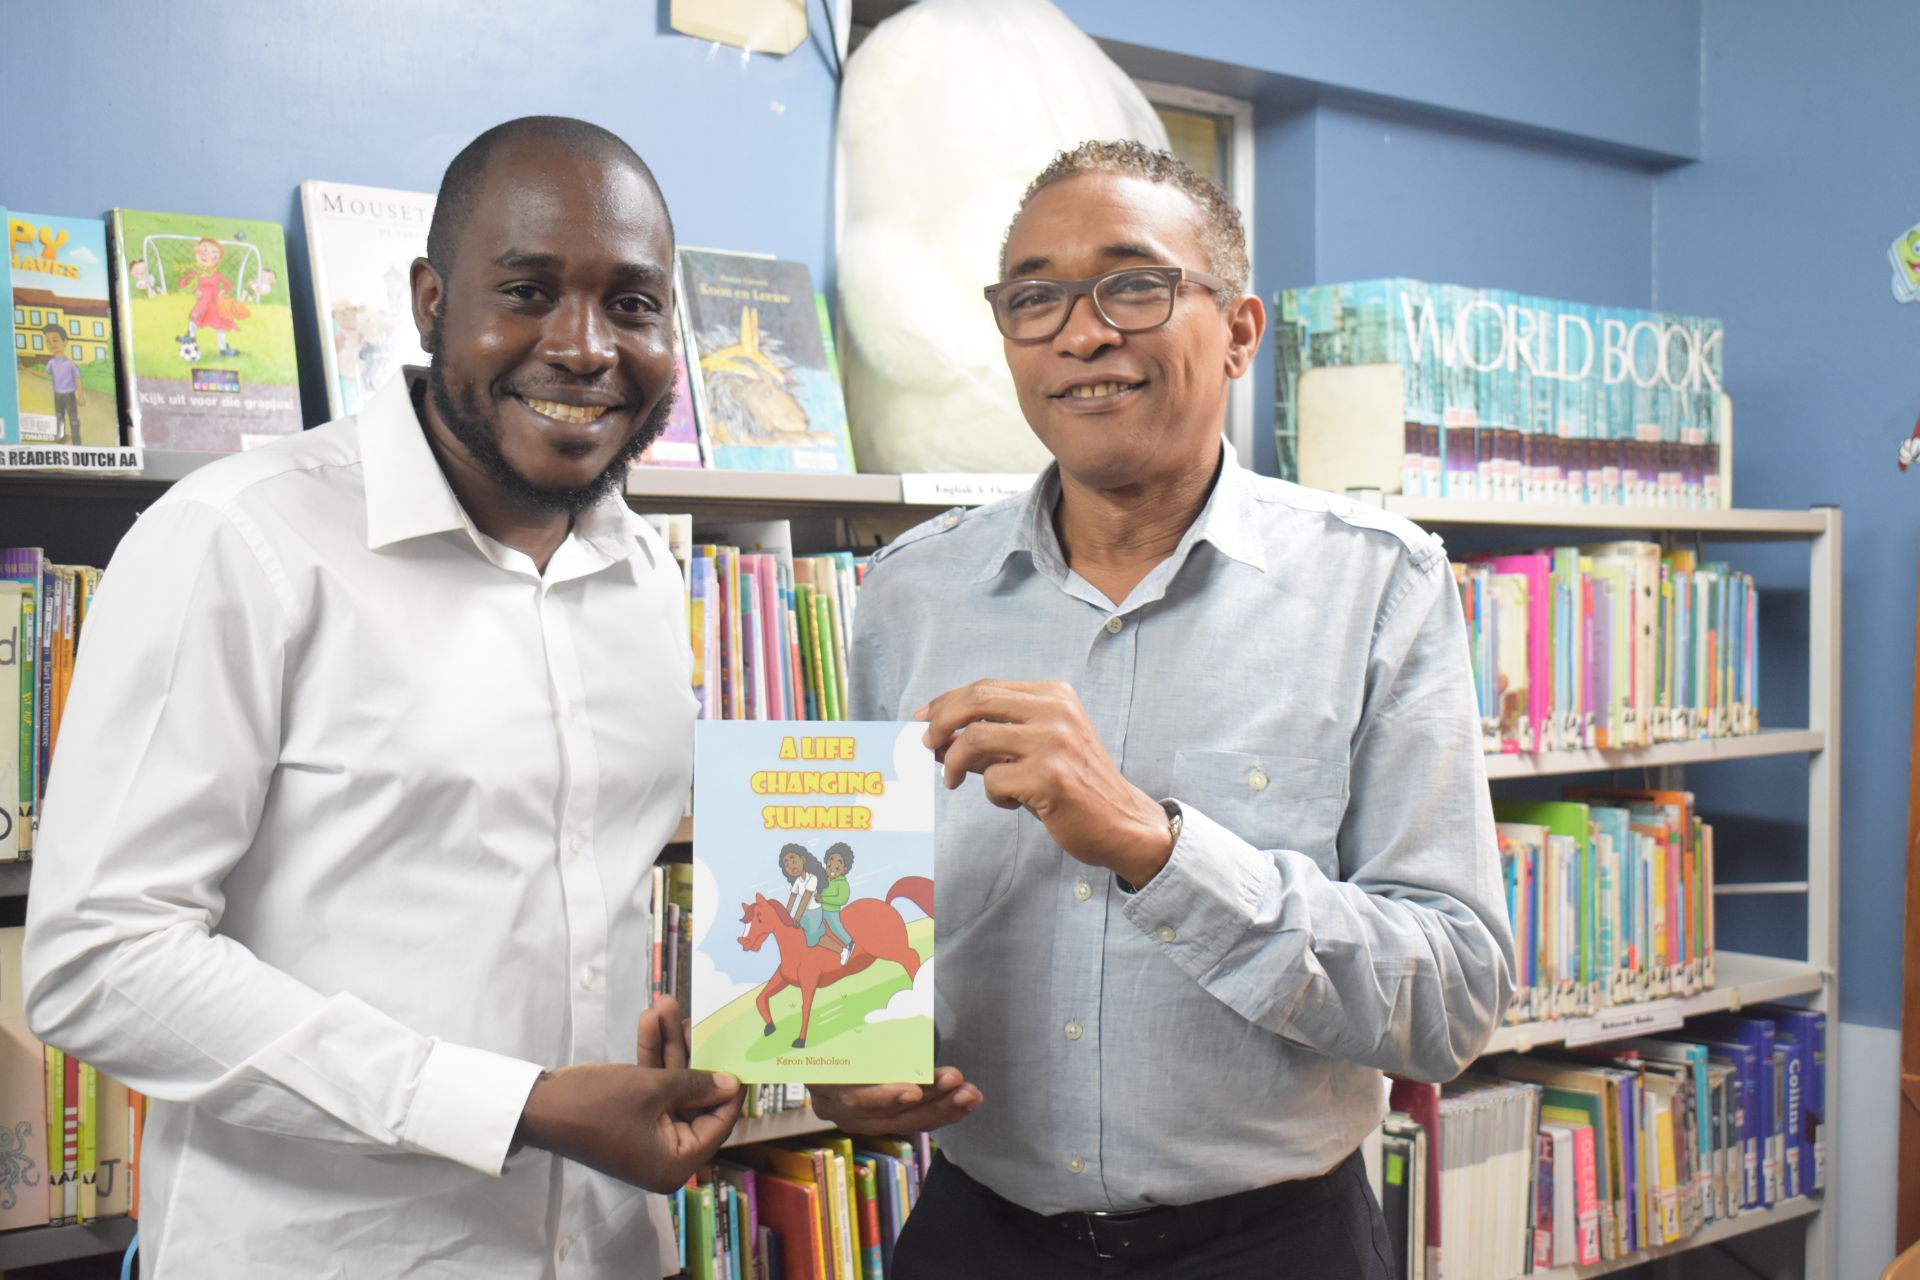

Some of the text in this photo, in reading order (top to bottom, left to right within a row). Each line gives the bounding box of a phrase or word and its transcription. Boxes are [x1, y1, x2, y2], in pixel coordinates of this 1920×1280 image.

[323, 193, 427, 223] MOUSET
[1401, 290, 1724, 393] WORLD BOOK
[140, 392, 165, 406] Kijk
[169, 394, 186, 406] uit
[190, 396, 218, 407] voor
[9, 450, 70, 467] READERS
[72, 452, 116, 467] DUTCH
[119, 453, 138, 467] AA
[43, 661, 51, 680] Bart
[779, 735, 856, 761] A LIFE
[750, 769, 885, 796] CHANGING
[761, 804, 873, 831] SUMMER
[776, 1055, 851, 1066] Keron Nicholson
[1788, 1058, 1801, 1135] Collins
